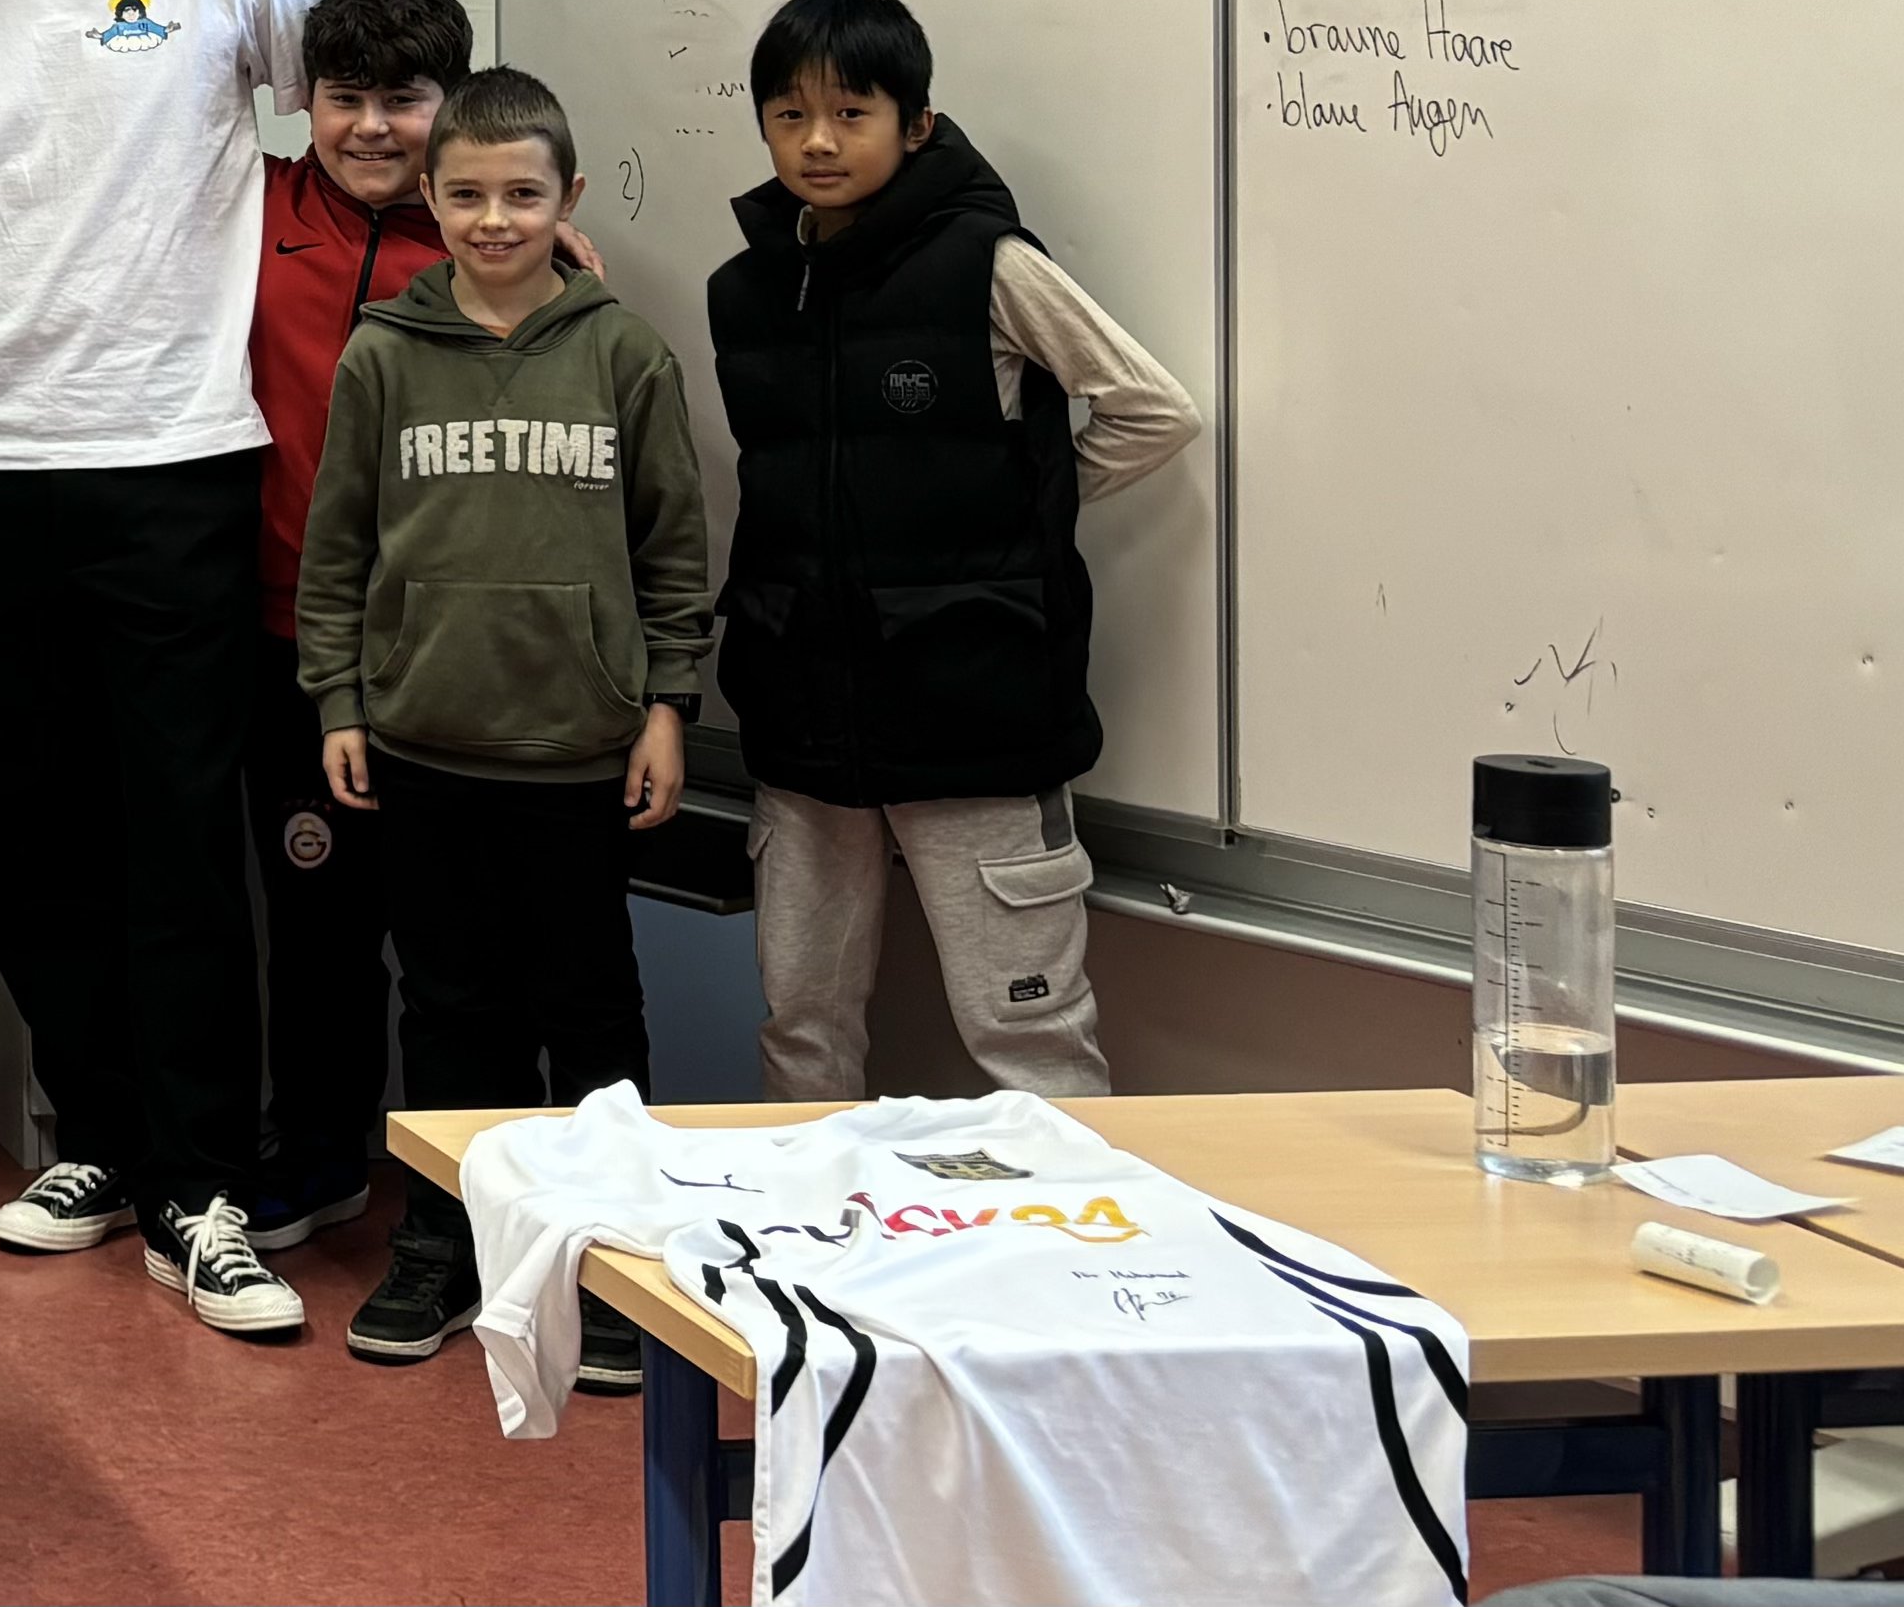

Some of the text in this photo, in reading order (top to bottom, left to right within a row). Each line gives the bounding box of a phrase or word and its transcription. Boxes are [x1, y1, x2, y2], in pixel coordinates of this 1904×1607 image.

[1277, 70, 1493, 158] blaue Augen
[890, 374, 929, 387] NYC
[399, 419, 617, 480] FREETIME
